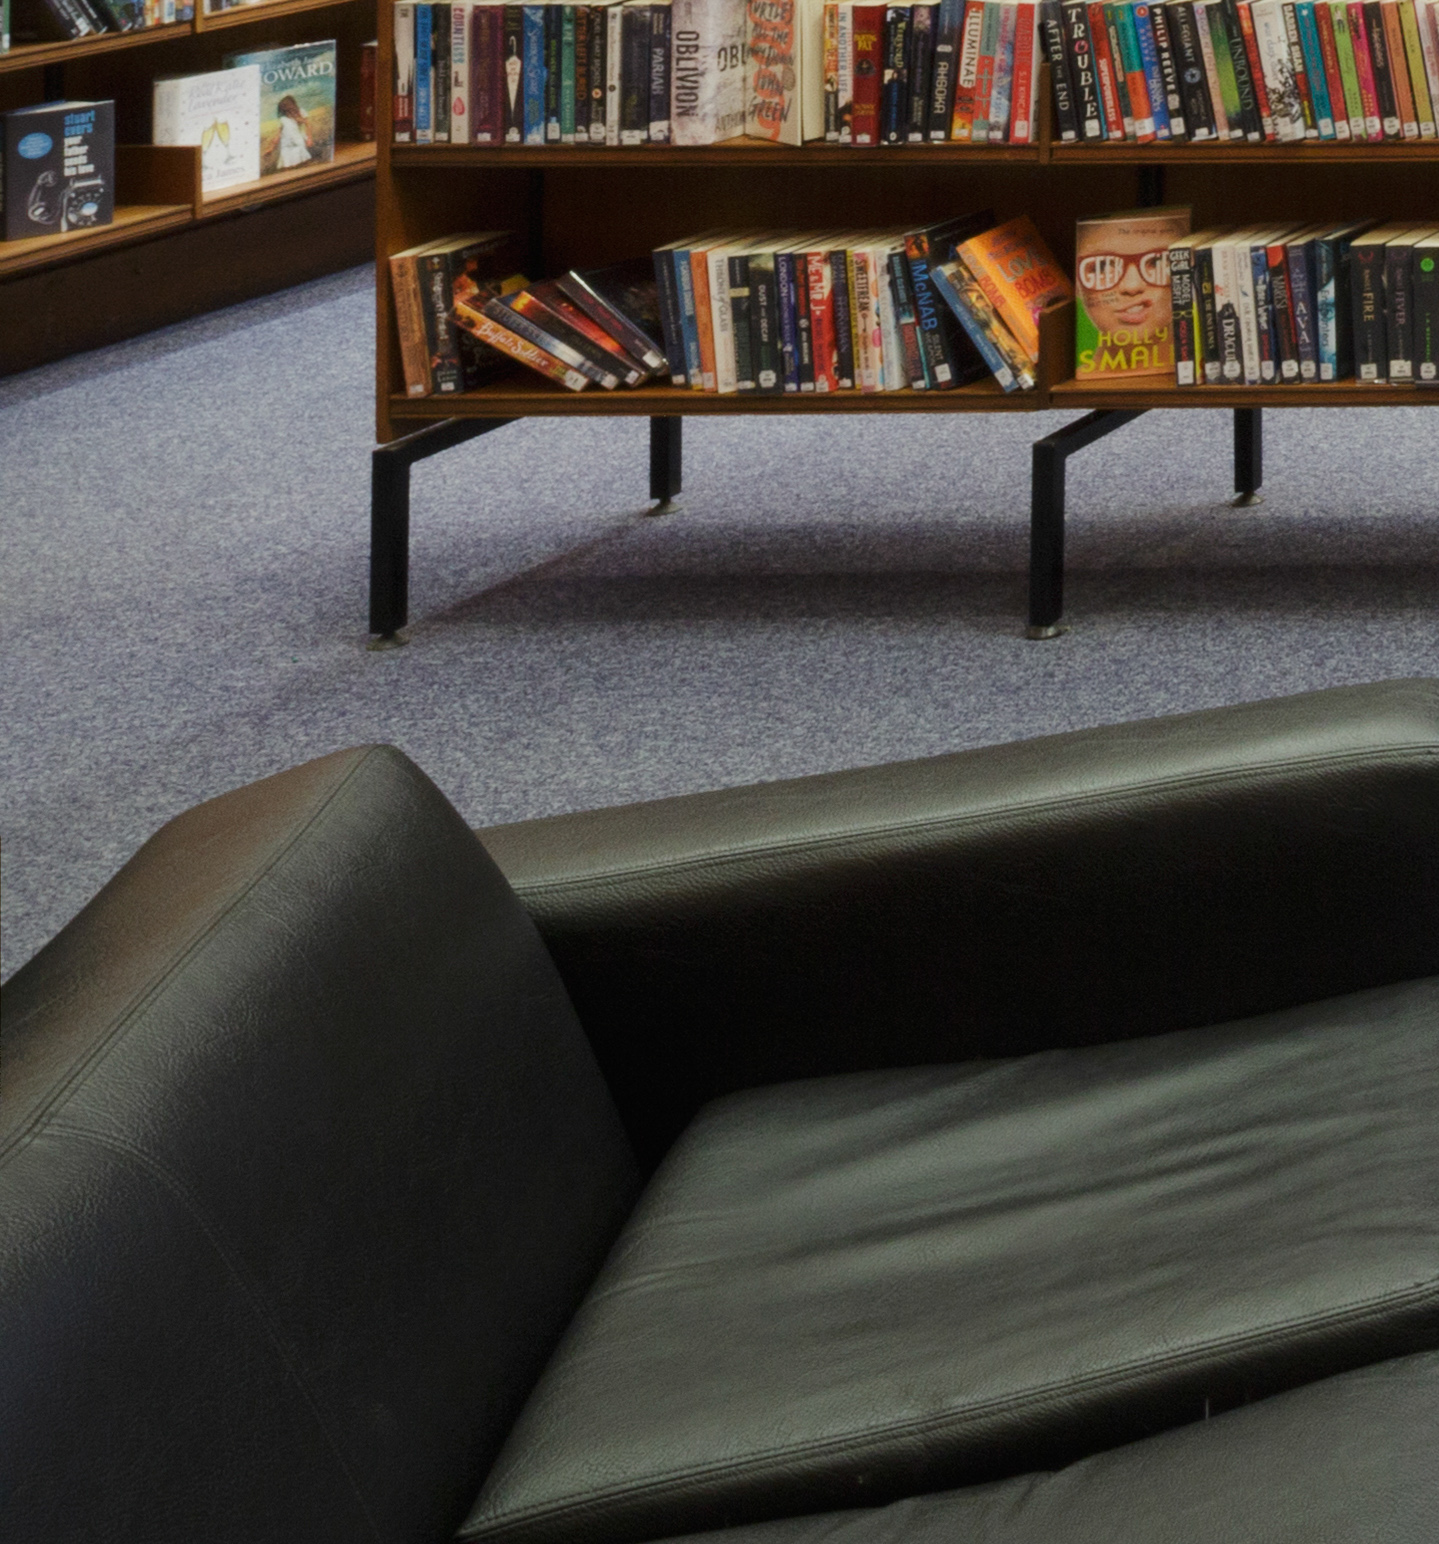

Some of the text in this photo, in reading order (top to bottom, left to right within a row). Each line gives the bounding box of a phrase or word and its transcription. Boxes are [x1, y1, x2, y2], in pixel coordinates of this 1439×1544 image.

[452, 7, 466, 65] COUNTLESS
[960, 10, 982, 87] ILLUMINAE
[1153, 7, 1176, 92] PHILIP REEVE
[1176, 6, 1196, 63] ALLEGIANT
[1283, 5, 1304, 73] DARREN SHAN
[652, 47, 665, 96] PARIAH
[675, 30, 699, 118] OBLIVION
[933, 61, 949, 115] AHSOKA
[1067, 8, 1098, 118] TROUBLE
[1098, 58, 1116, 122] SUPERPOWERLESS
[777, 256, 789, 299] LONDON
[1169, 250, 1190, 261] GEEK
[853, 258, 871, 313] SWEETFREAK
[1171, 275, 1182, 306] MISFIT
[1181, 274, 1191, 305] MODEL
[1361, 291, 1376, 322] FIRE
[1097, 326, 1169, 348] HOLLY
